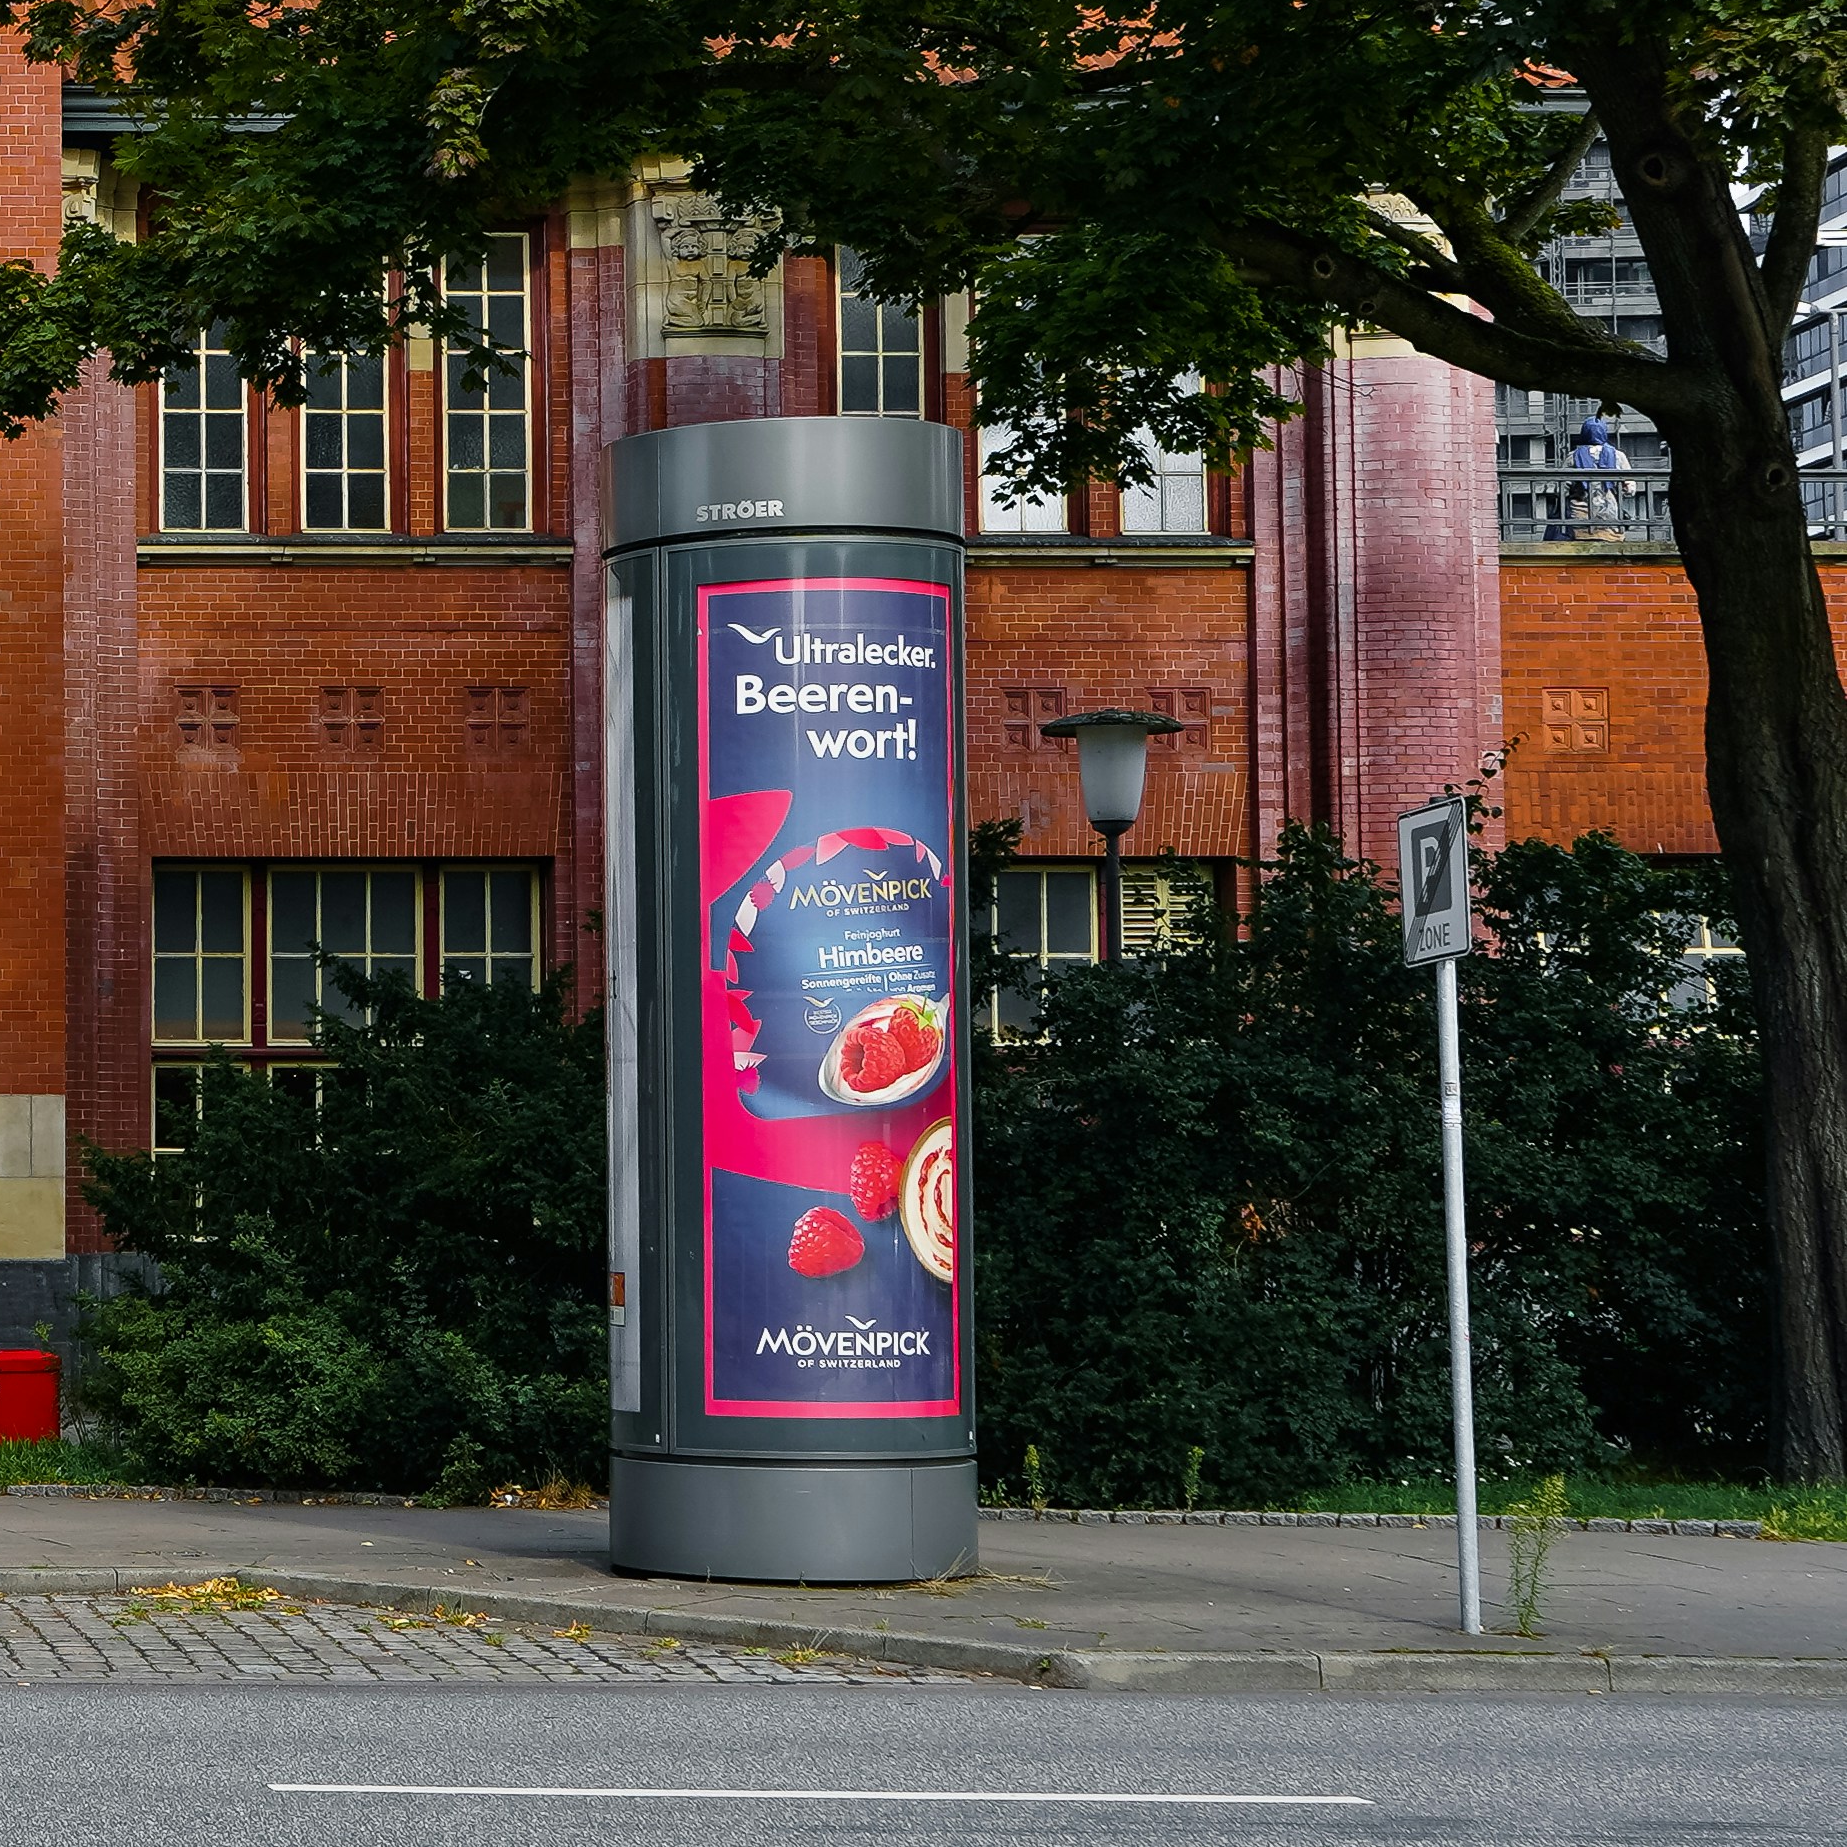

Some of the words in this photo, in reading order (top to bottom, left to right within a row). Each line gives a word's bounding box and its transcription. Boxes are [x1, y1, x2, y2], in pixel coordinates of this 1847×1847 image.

[696, 499, 785, 523] STRÖER
[775, 633, 937, 669] Ultralecker.
[736, 674, 913, 715] Beeren-
[806, 718, 918, 761] wort!
[789, 877, 932, 910] MÖVENPICK
[826, 909, 840, 918] OF
[844, 903, 910, 916] SWITZERLAND
[844, 927, 901, 941] Feinjoghurt
[1419, 922, 1451, 952] ZONE
[818, 942, 923, 969] Himbeere
[801, 973, 882, 990] Sonnengereifte
[888, 971, 913, 982] Ohne
[756, 1324, 931, 1356] MÖVENPICK
[797, 1359, 814, 1369] OF
[819, 1359, 902, 1369] SWITZERLAND
